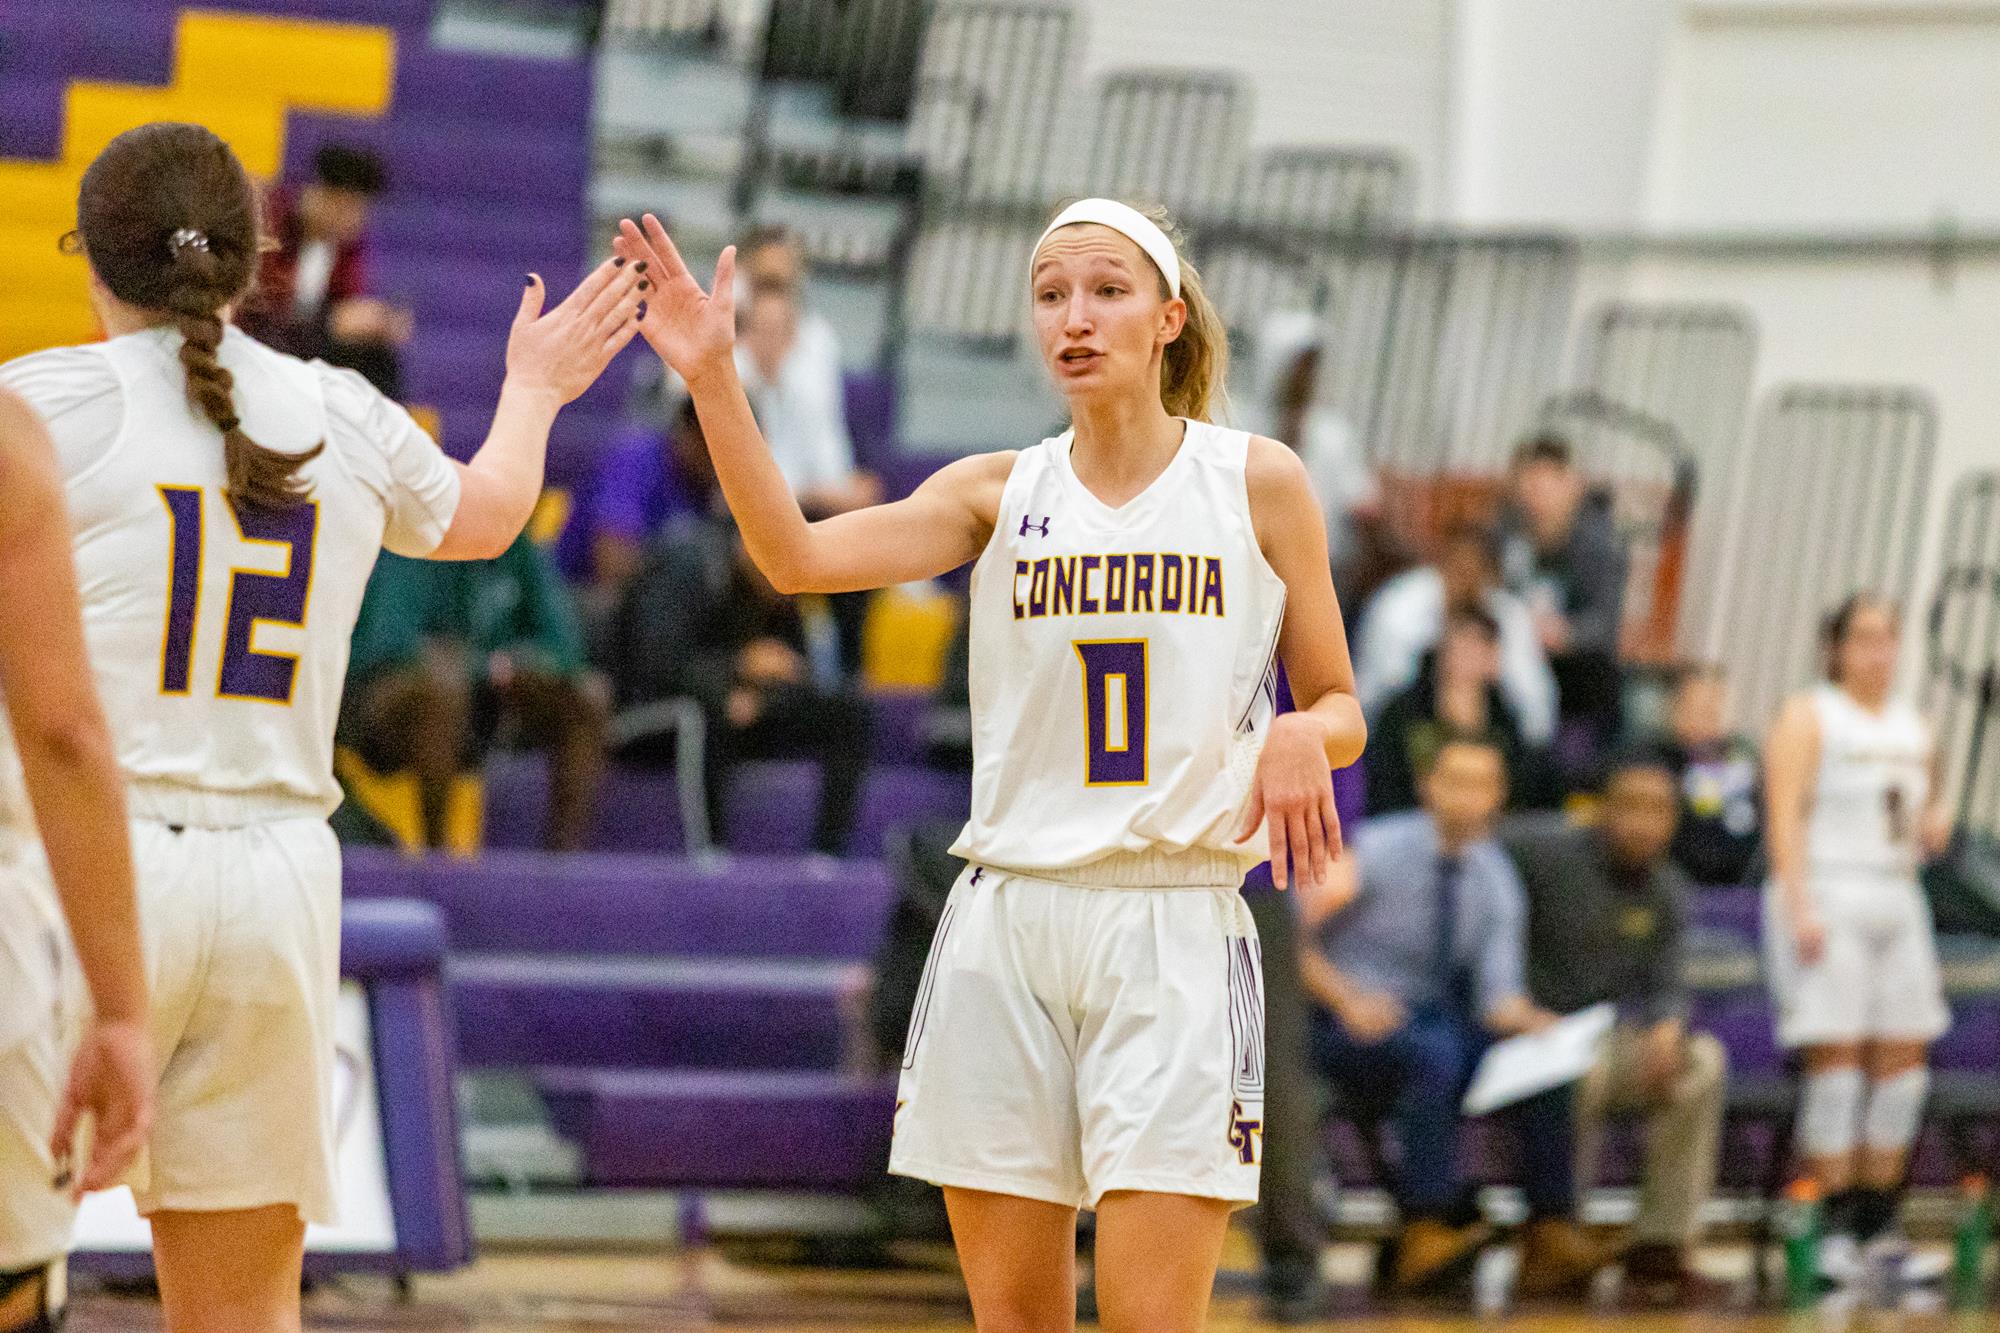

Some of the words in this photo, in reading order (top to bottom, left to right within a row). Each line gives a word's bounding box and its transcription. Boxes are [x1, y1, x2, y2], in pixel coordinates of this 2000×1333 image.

[155, 483, 320, 706] 12
[1013, 551, 1224, 620] CONCORDIA
[1071, 637, 1149, 787] 0
